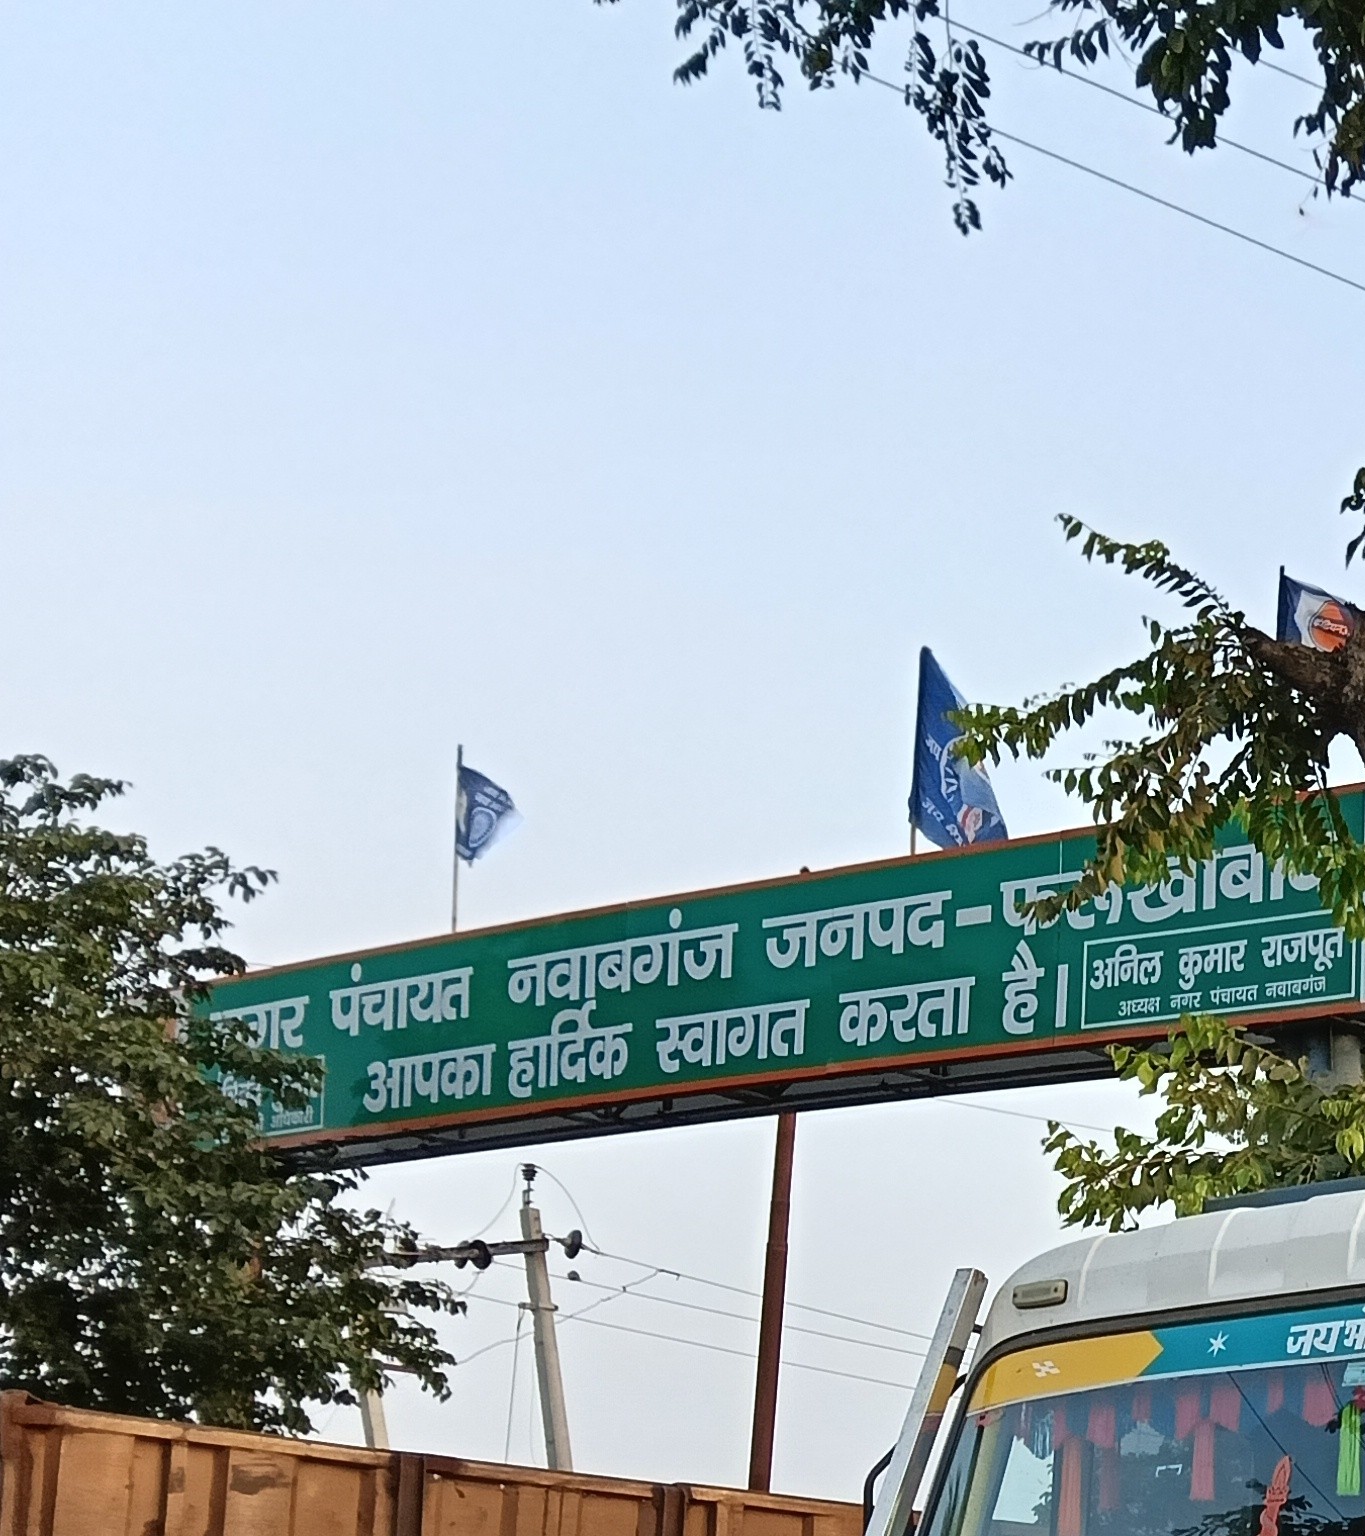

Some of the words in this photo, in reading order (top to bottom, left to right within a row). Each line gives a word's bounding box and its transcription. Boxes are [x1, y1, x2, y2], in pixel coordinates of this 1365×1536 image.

[329, 962, 474, 1036] पंचायत
[507, 908, 739, 1006] नवाबगंज
[1090, 943, 1164, 990] अनिल
[1179, 939, 1248, 990] कुमार
[1261, 927, 1346, 972] राजपूत
[1118, 996, 1160, 1017] अध्यक्ष
[1170, 992, 1202, 1010] नगर
[1210, 984, 1259, 1006] पंचायत
[1265, 974, 1326, 999] नवाबगंज
[363, 1043, 497, 1113] आपका
[508, 999, 633, 1098] हार्दिक
[655, 998, 810, 1074] स्वागत
[839, 976, 975, 1047] करता
[1286, 1320, 1345, 1356] जय
